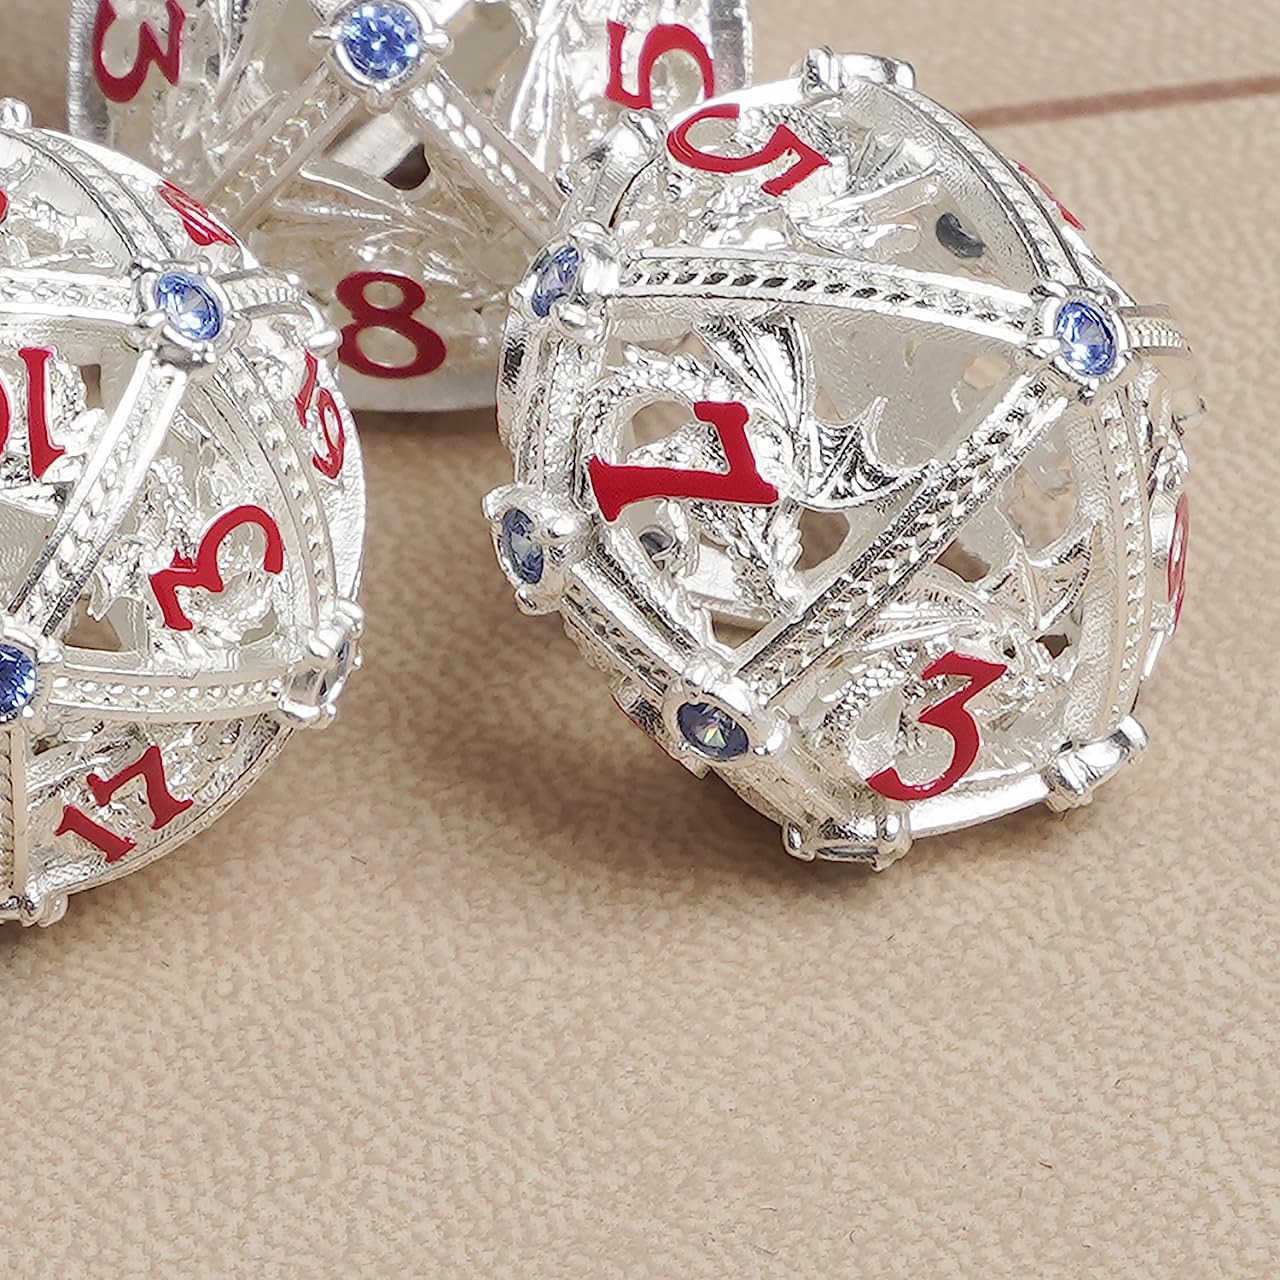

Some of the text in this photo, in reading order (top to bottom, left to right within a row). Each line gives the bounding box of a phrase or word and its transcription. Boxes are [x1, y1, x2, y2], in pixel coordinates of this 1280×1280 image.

[605, 21, 715, 110] 5
[666, 105, 830, 197] 5
[336, 271, 446, 378] 8
[588, 400, 779, 522] 1
[150, 504, 284, 631] 3
[867, 651, 1007, 802] 3
[55, 745, 193, 864] 17
